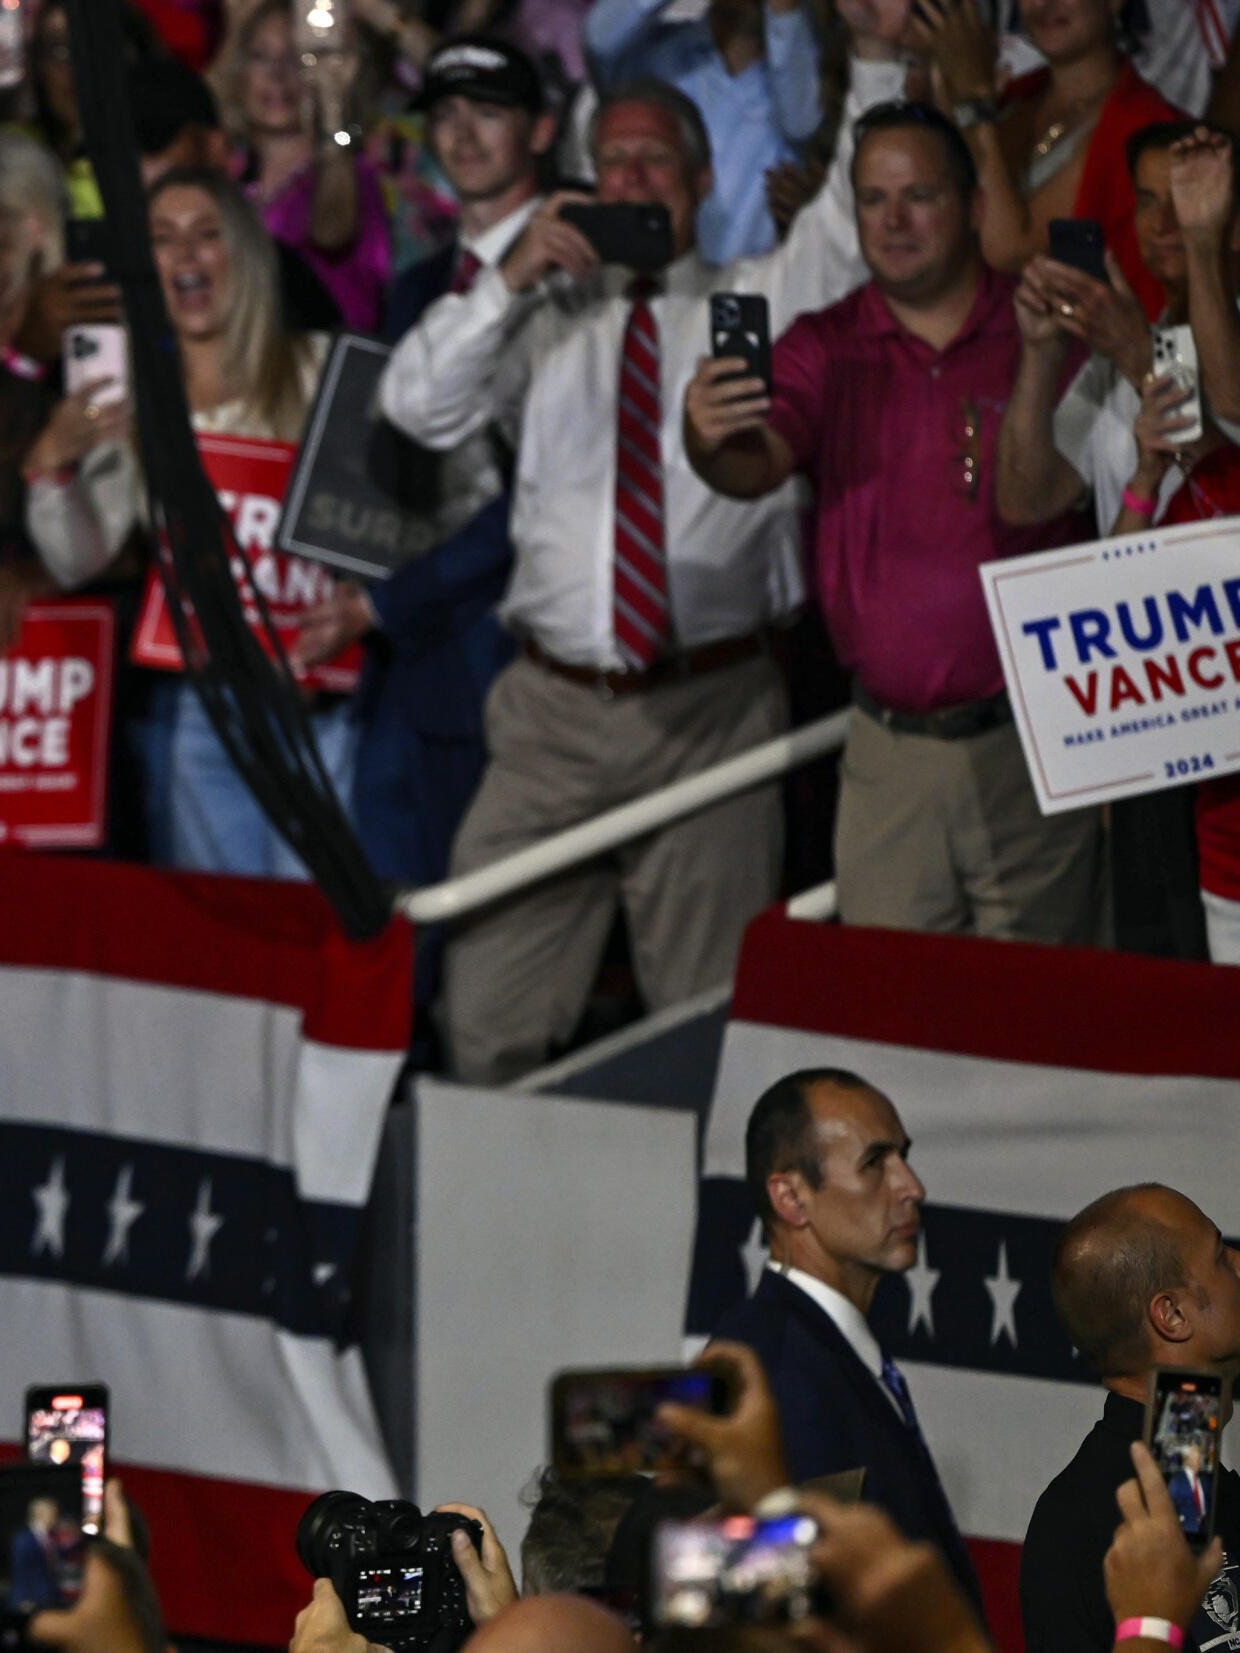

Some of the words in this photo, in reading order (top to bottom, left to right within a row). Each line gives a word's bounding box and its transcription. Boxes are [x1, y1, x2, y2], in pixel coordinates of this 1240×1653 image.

[1063, 726, 1106, 748] MAKE
[1110, 712, 1176, 739] AMERICA
[1180, 699, 1228, 723] GREAT
[1164, 753, 1216, 779] 2024
